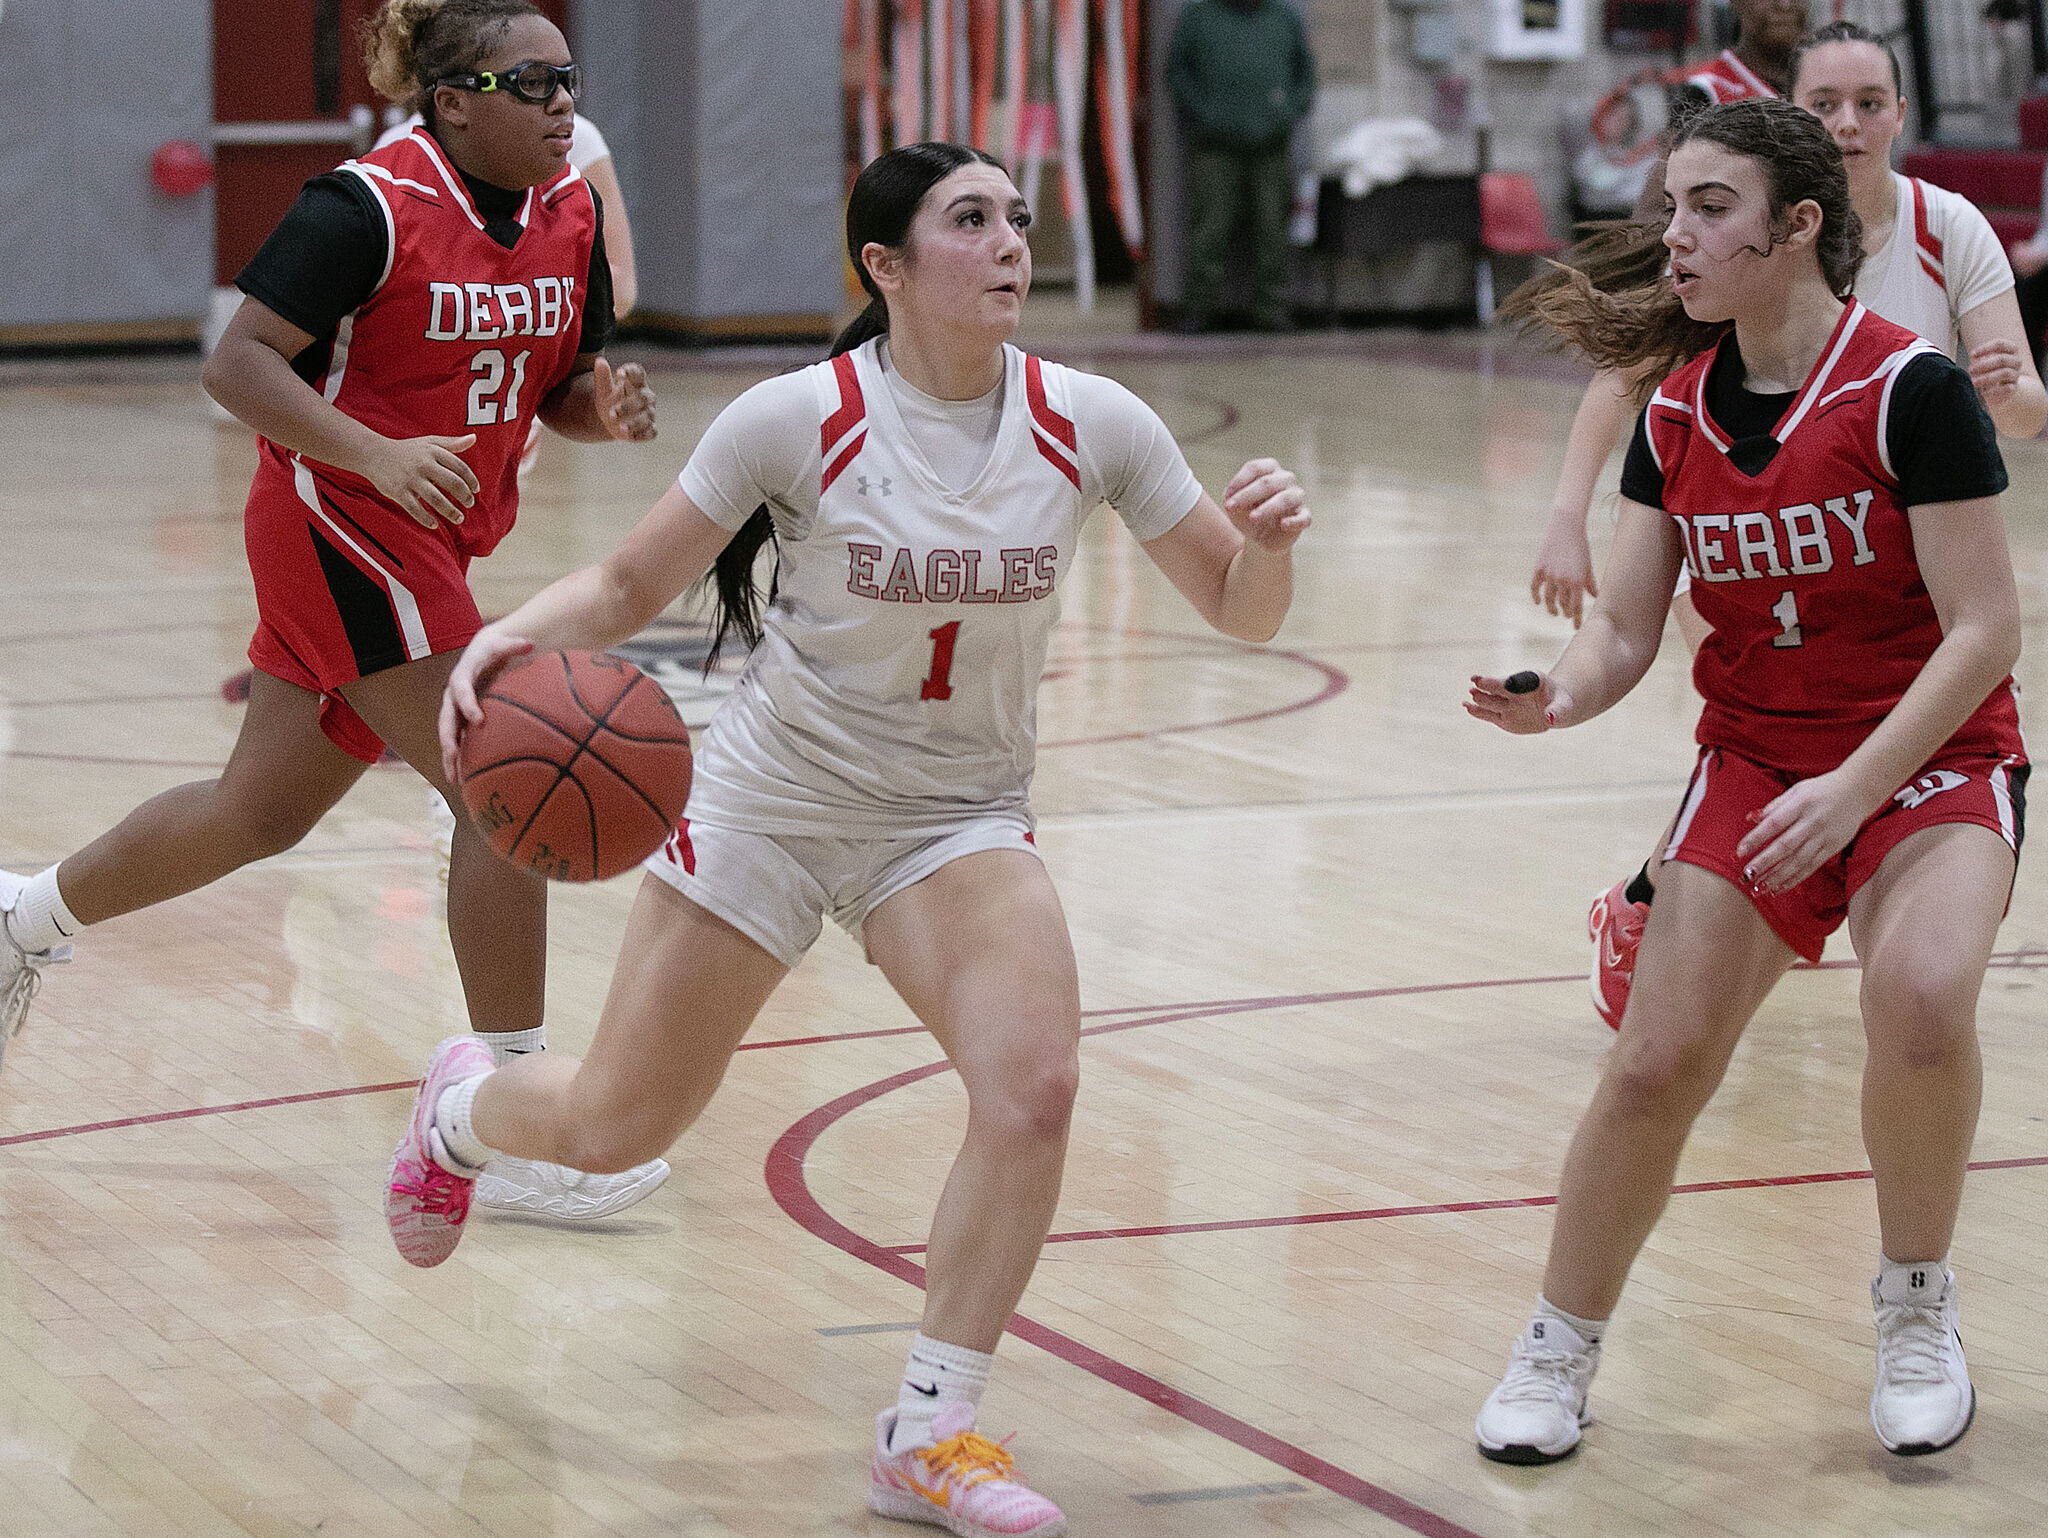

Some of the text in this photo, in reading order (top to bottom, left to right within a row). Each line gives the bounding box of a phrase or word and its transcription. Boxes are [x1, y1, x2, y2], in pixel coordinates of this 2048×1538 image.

[465, 348, 533, 427] 21
[846, 541, 1058, 604] EAGLES
[1771, 590, 1802, 649] 1
[919, 620, 964, 702] 1
